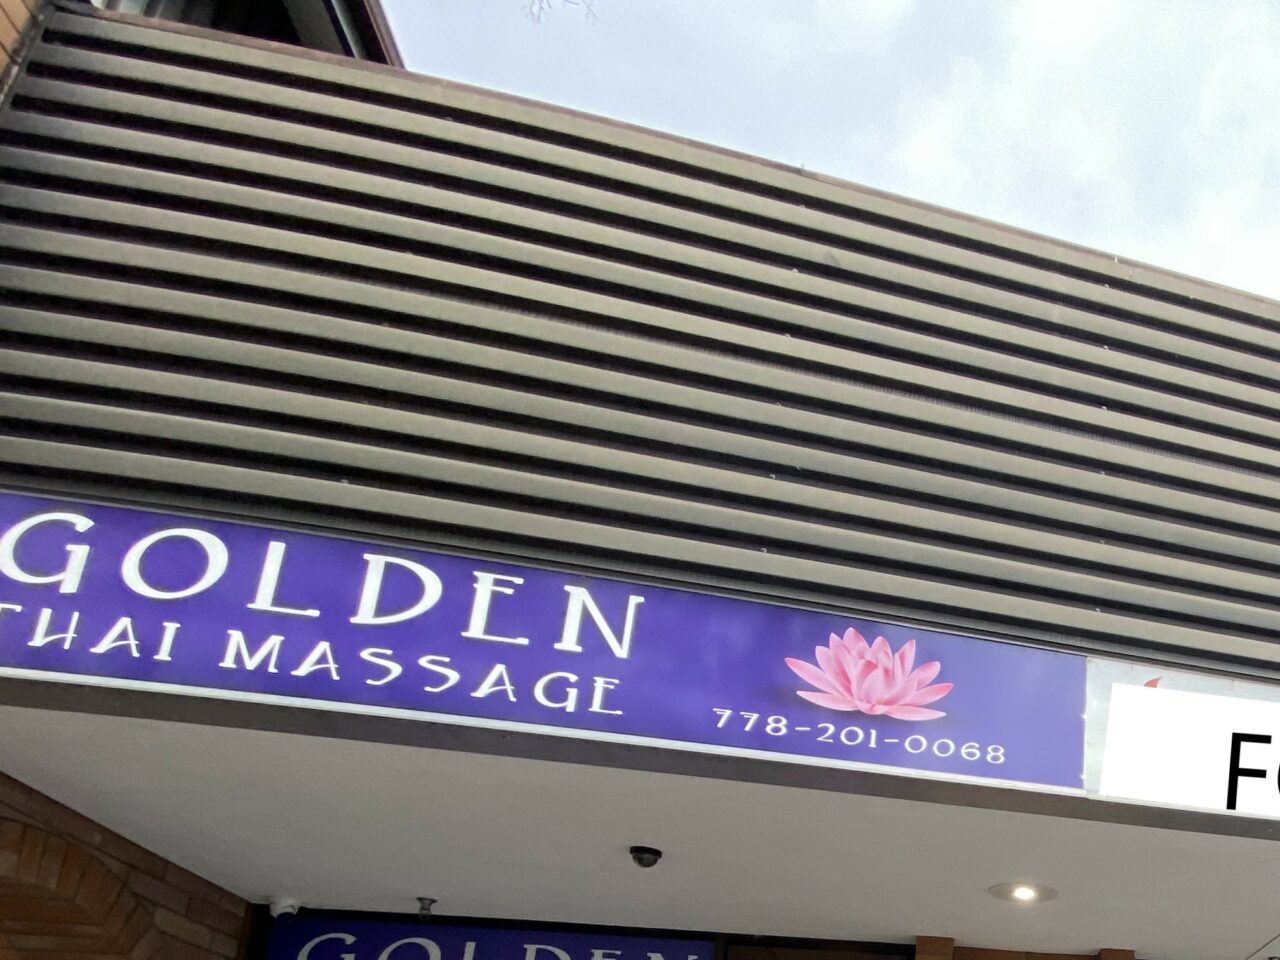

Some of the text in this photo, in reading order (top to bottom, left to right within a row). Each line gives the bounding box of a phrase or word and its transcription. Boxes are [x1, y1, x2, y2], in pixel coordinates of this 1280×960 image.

[0, 511, 645, 658] GOLDEN
[218, 629, 624, 716] MASSAGE
[713, 707, 1006, 764] 778-201-0068
